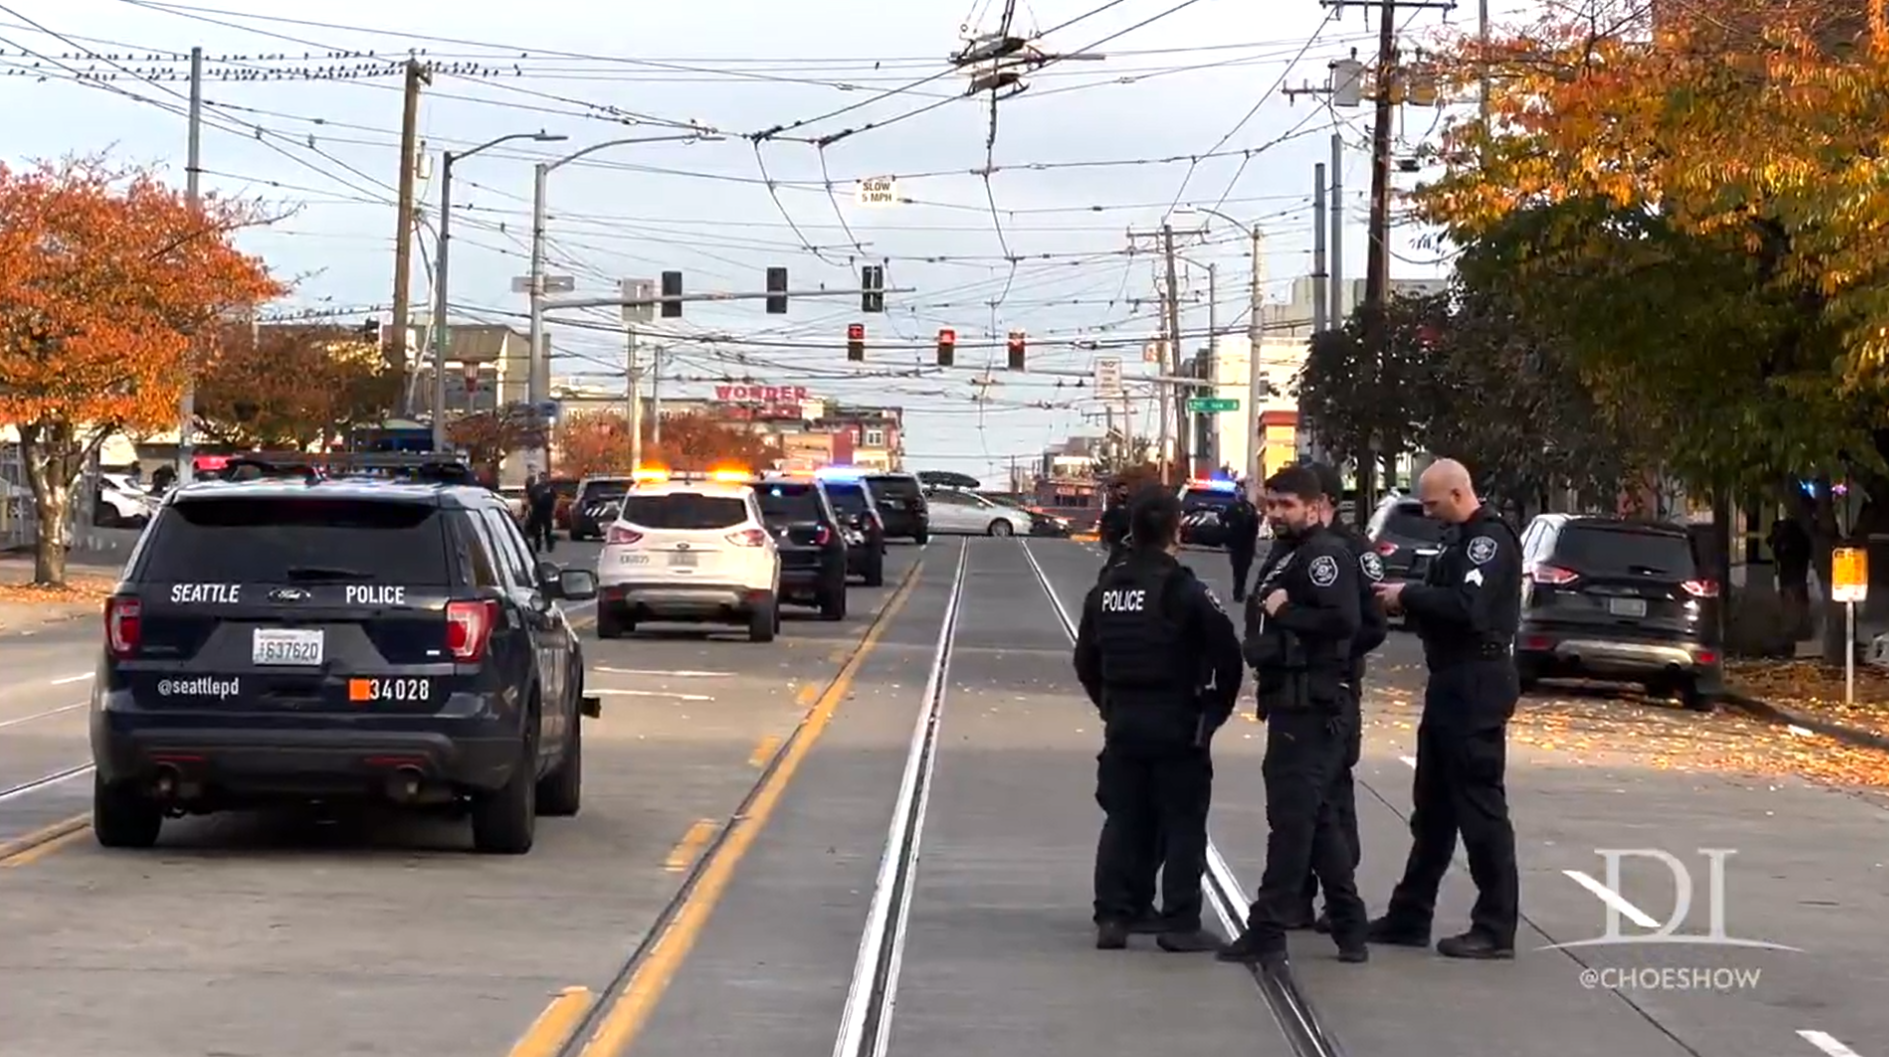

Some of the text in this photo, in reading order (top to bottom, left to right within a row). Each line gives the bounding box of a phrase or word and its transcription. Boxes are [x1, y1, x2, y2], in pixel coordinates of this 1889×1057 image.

[863, 182, 891, 191] SLOW
[862, 193, 892, 203] 5 MPH
[715, 385, 807, 400] WONDER
[170, 583, 241, 604] SEATTLE
[345, 585, 406, 605] POLICE
[1102, 589, 1146, 612] POLICE
[265, 641, 319, 661] 637620
[157, 677, 240, 700] @seattlepd
[369, 679, 430, 700] 34028
